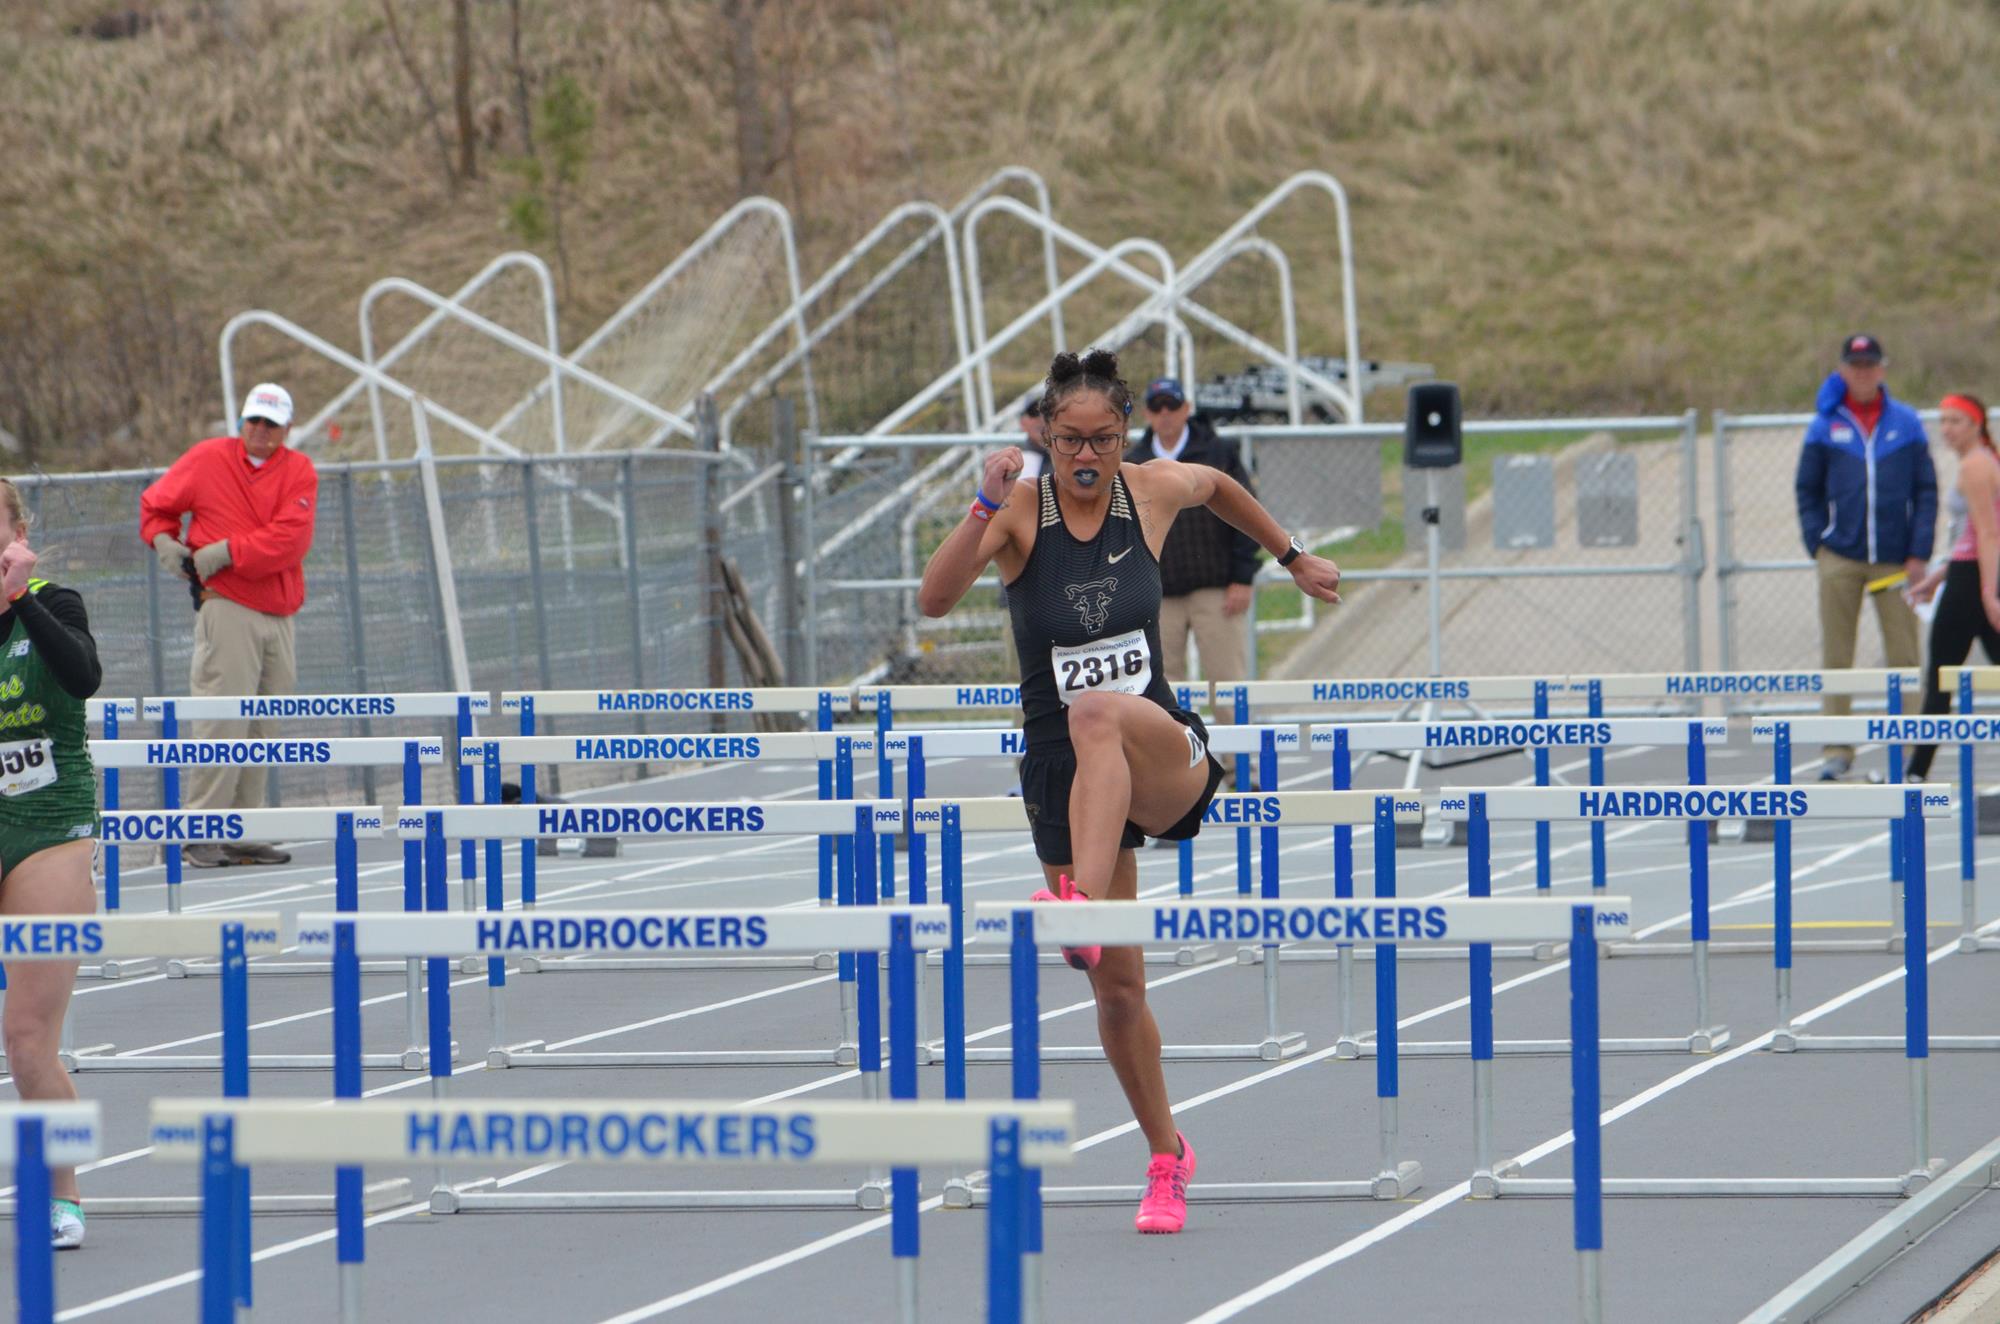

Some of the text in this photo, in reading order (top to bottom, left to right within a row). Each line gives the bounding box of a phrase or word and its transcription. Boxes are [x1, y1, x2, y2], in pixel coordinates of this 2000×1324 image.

[1082, 637, 1141, 654] CHAMPIONSHIP
[1062, 649, 1143, 691] 2316
[1313, 682, 1470, 701] HARDROCKERS
[1666, 674, 1823, 694] HARDROCKERS
[240, 697, 396, 717] HARDROCKERS
[598, 692, 754, 711] HARDROCKERS
[1425, 723, 1612, 747] HARDROCKERS
[0, 742, 44, 777] 56
[147, 742, 331, 764] HARDROCKERS
[576, 737, 761, 760] HARDROCKERS
[1580, 790, 1809, 818] HARDROCKERS
[102, 813, 244, 841] ROCKERS
[538, 805, 765, 834] HARDROCKERS
[477, 915, 768, 950] HARDROCKERS
[1154, 907, 1448, 940] HARDROCKERS
[407, 1112, 818, 1160] HARDROCKERS
